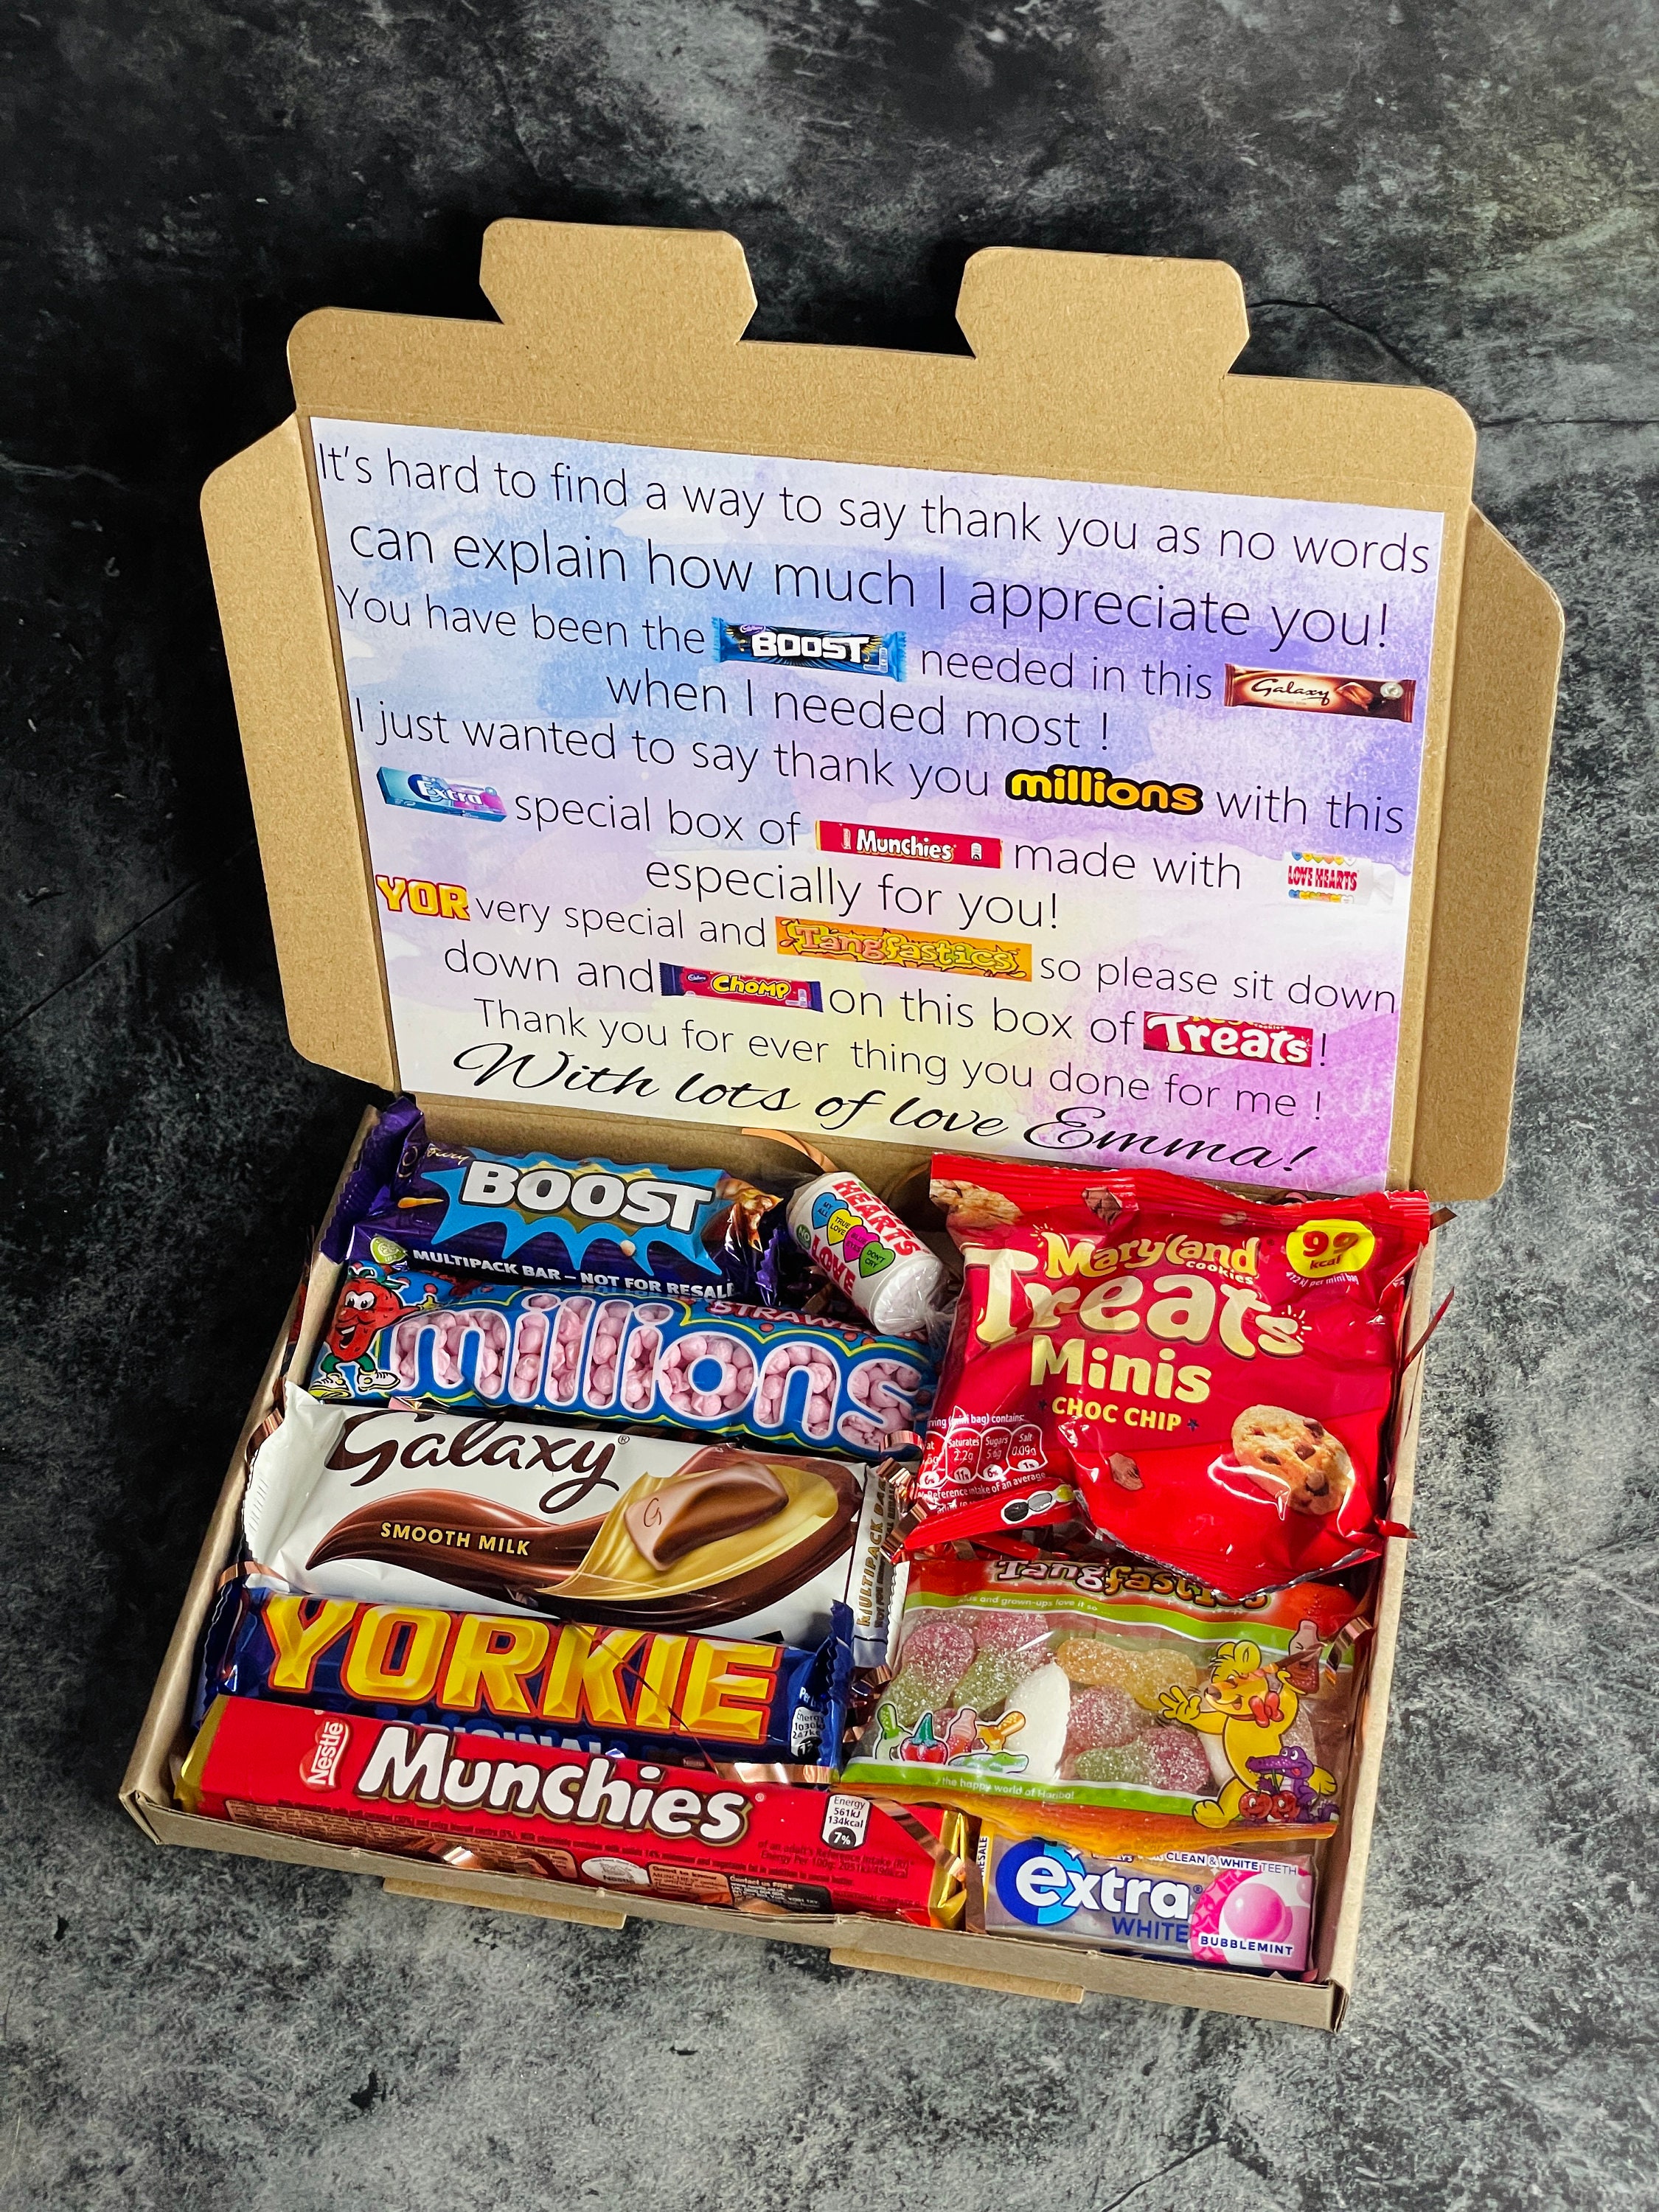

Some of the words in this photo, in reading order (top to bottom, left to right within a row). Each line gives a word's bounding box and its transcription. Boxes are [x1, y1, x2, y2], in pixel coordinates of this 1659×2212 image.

[319, 442, 372, 484] It's
[386, 447, 479, 494] hard
[493, 462, 536, 498] to
[550, 462, 627, 507] find
[646, 482, 667, 510] a
[682, 485, 765, 529] way
[779, 487, 821, 524] to
[839, 498, 906, 541] say
[920, 494, 1042, 543] thank
[1057, 516, 1137, 556] you
[1156, 524, 1200, 555] as
[1220, 529, 1275, 561] no
[1293, 532, 1429, 574] words
[349, 525, 434, 564] can
[453, 528, 626, 585] explain
[647, 538, 753, 593] how
[775, 559, 914, 608] much
[939, 566, 945, 610] I
[970, 581, 1250, 636] appreciate
[1269, 602, 1387, 653] you!
[336, 585, 411, 627] You
[425, 593, 516, 637] have
[532, 603, 627, 648] been
[641, 615, 705, 654] the
[751, 631, 870, 663] BOOST
[922, 647, 1073, 689] needed
[1093, 656, 1124, 693] in
[1141, 659, 1212, 700] this
[1251, 678, 1329, 706] Galaxy
[605, 667, 726, 714] when
[747, 678, 753, 717] I
[774, 689, 945, 735] needed
[967, 710, 1081, 748] most
[355, 697, 364, 733] I
[375, 700, 450, 746] just
[462, 720, 616, 759] wanted
[631, 730, 675, 765] to
[692, 742, 759, 783] say
[773, 740, 894, 787] thank
[908, 763, 988, 800] you
[1011, 768, 1197, 811] millions
[1216, 785, 1307, 825] with
[1326, 791, 1404, 834] this
[417, 780, 483, 805] Extra
[515, 795, 650, 832] special
[668, 799, 744, 841] box
[759, 811, 801, 846] of
[856, 828, 952, 860] Munchies
[1015, 841, 1135, 880] made
[1152, 852, 1240, 890] with
[1288, 866, 1312, 886] LOVE
[1315, 868, 1357, 891] HEARTS
[646, 861, 862, 917] especially
[877, 873, 942, 916] for
[958, 892, 1057, 931] you!
[376, 874, 471, 922] YOR
[475, 897, 550, 933] very
[564, 907, 684, 939] special
[700, 917, 765, 948] and
[794, 925, 1013, 971] Tangfastics
[1040, 957, 1081, 982] so
[1098, 956, 1217, 995] please
[1233, 970, 1274, 1001] sit
[1287, 974, 1395, 1014] down
[444, 939, 559, 983] down
[577, 958, 654, 993] and
[829, 989, 883, 1018] on
[899, 988, 974, 1028] this
[993, 996, 1073, 1040] box
[1090, 1010, 1136, 1046] of
[1147, 1015, 1308, 1063] Treats
[473, 998, 588, 1038] Thank
[599, 1018, 667, 1048] you
[681, 1019, 734, 1053] for
[748, 1035, 830, 1063] ever
[849, 1038, 946, 1085] thing
[961, 1059, 1032, 1089] you
[1049, 1061, 1150, 1100] done
[1164, 1073, 1220, 1107] for
[1236, 1090, 1296, 1117] me
[453, 1043, 660, 1098] With
[675, 1072, 801, 1111] lots
[814, 1089, 886, 1130] of
[889, 1096, 1009, 1137] love
[1023, 1105, 1320, 1172] Emma!
[462, 1161, 714, 1231] BOOST
[822, 1201, 834, 1211] MY
[817, 1208, 829, 1218] ALL
[832, 1180, 922, 1256] HEARTS
[835, 1216, 852, 1229] TRUE
[798, 1225, 810, 1242] NO
[830, 1222, 846, 1237] LOVE
[1302, 1231, 1360, 1258] 99
[810, 1234, 857, 1298] LOVE
[864, 1258, 879, 1269] CRY
[866, 1249, 886, 1263] DON'T
[1040, 1232, 1261, 1279] Maryland
[1309, 1254, 1343, 1270] kcal
[413, 1249, 519, 1276] MULTIPACK
[522, 1265, 562, 1281] BAR
[580, 1272, 620, 1287] NOT
[624, 1277, 662, 1293] FOR
[1185, 1259, 1254, 1286] cookies
[963, 1247, 1304, 1358] Treats
[389, 1292, 923, 1451] millions
[1029, 1334, 1213, 1404] Minis
[970, 1413, 990, 1425] bag)
[991, 1414, 1025, 1423] contains:
[1051, 1396, 1119, 1425] CHOC
[1123, 1405, 1183, 1433] CHIP
[948, 1438, 980, 1448] Saturates
[985, 1436, 1009, 1447] Sugars
[1012, 1446, 1037, 1457] 0.09g
[1019, 1433, 1033, 1442] Salt
[327, 1411, 620, 1514] Galaxy
[953, 1450, 974, 1462] 2.2g
[928, 1486, 968, 1500] Reference
[992, 1481, 1001, 1493] of
[1001, 1480, 1012, 1490] an
[1013, 1472, 1046, 1486] average
[380, 1523, 471, 1548] SMOOTH
[477, 1534, 530, 1556] MILK
[1001, 1597, 1053, 1608] grown-ups
[1055, 1597, 1075, 1606] love
[1077, 1600, 1085, 1608] it
[262, 1595, 779, 1742] YORKIE
[307, 1720, 345, 1786] Nestlé
[358, 1725, 745, 1841] Munchies
[942, 1777, 957, 1787] the
[959, 1778, 991, 1792] happy
[994, 1784, 1023, 1795] world
[1024, 1788, 1036, 1798] of
[834, 1795, 866, 1811] Energy
[834, 1807, 860, 1818] 561kJ
[827, 1815, 863, 1829] 134kcal
[833, 1831, 851, 1846] 7%
[1166, 1851, 1206, 1865] CLEAN
[1209, 1856, 1217, 1866] &
[1220, 1857, 1259, 1871] WHITE
[1260, 1861, 1297, 1876] TEETH
[1015, 1855, 1190, 1920] extra
[1111, 1916, 1189, 1944] WHITE
[1200, 1935, 1294, 1956] BUBBLEMINT
